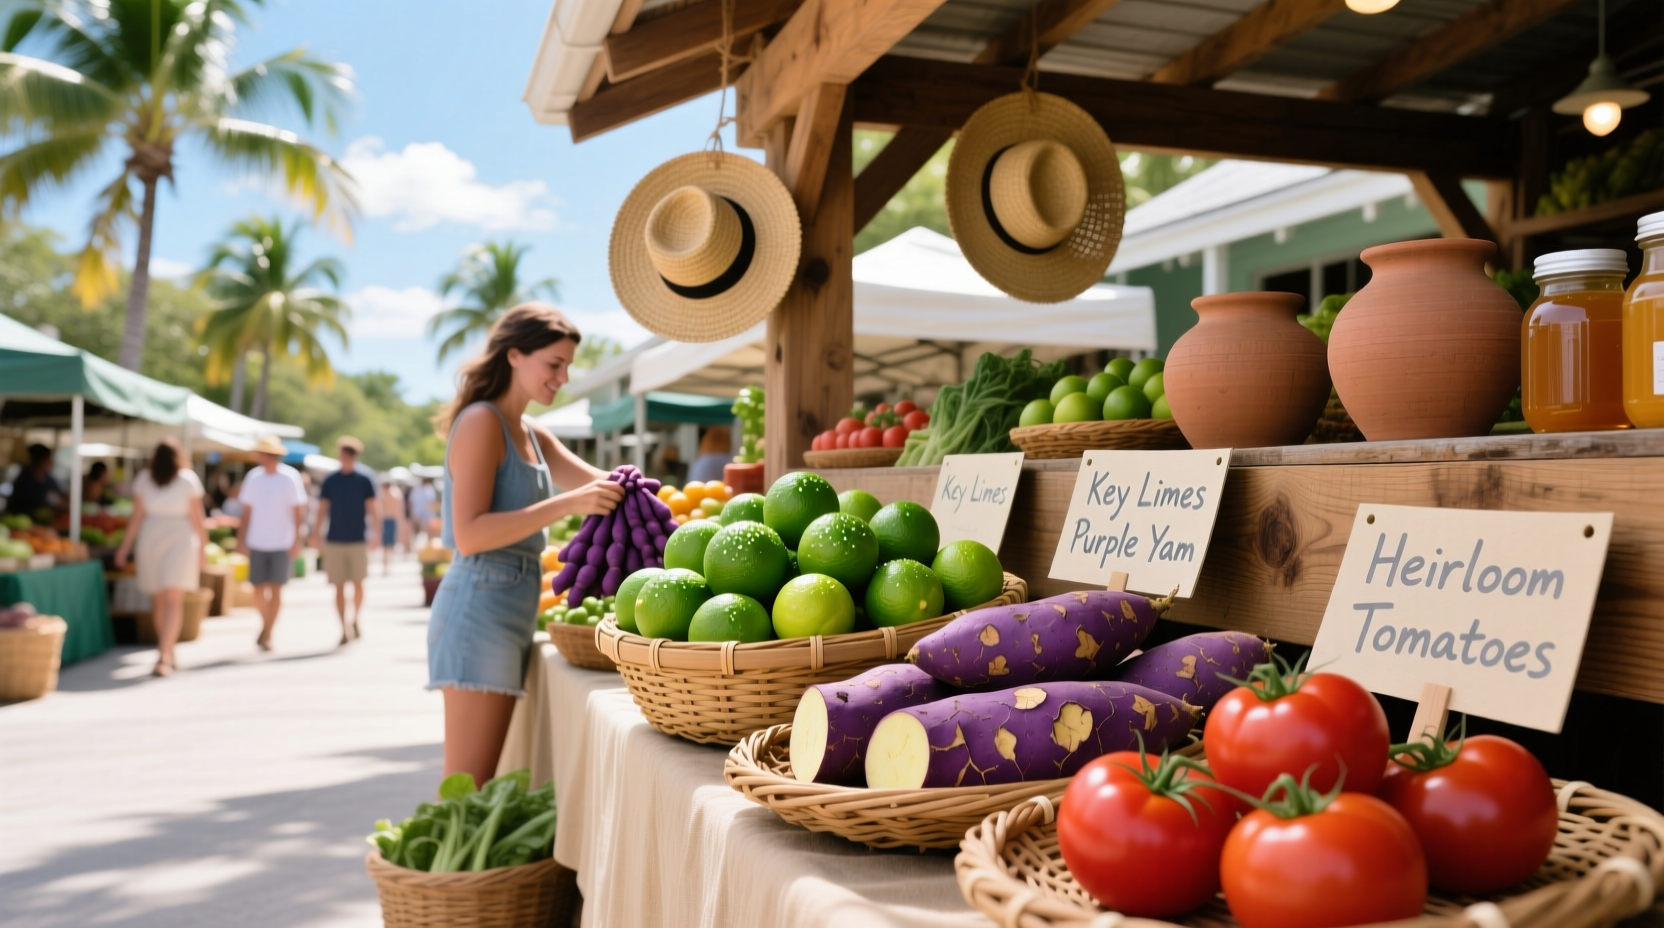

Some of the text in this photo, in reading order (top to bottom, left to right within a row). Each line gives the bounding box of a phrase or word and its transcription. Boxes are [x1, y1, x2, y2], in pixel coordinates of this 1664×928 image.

[941, 474, 967, 514] Key
[1087, 470, 1207, 521] Key Limes
[1070, 518, 1195, 569] Purple Yam
[1365, 532, 1565, 600] Heirloom
[1353, 602, 1556, 679] Tomatoes
